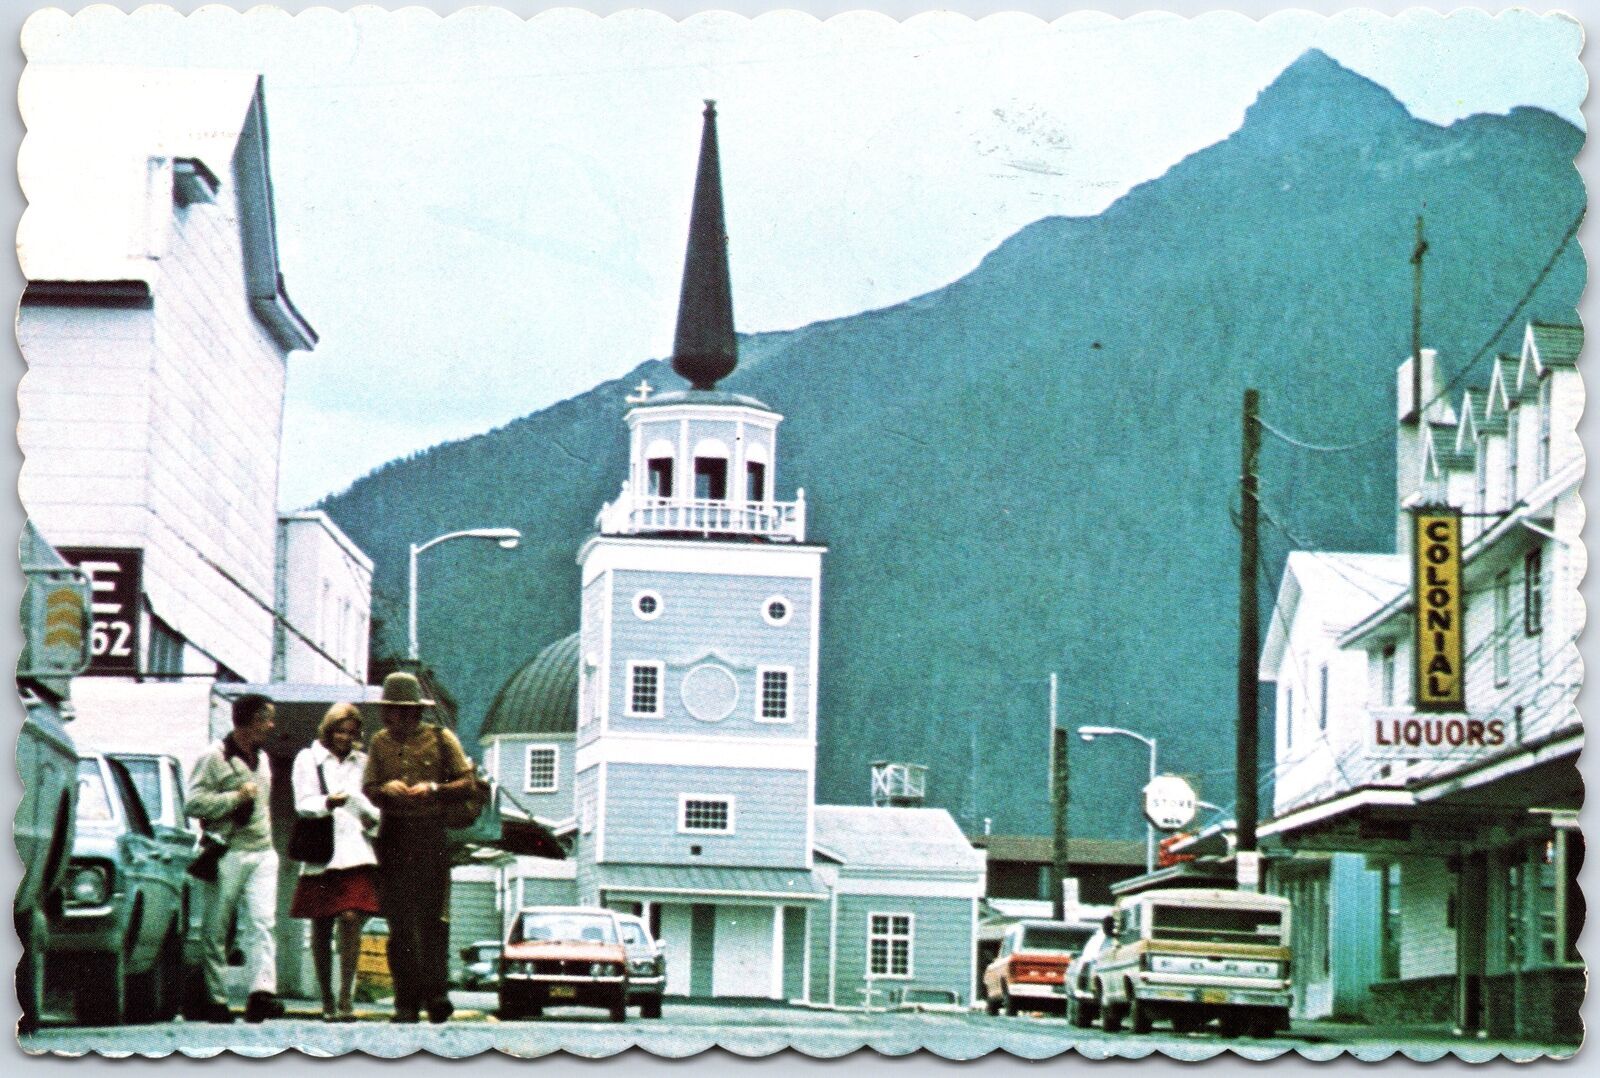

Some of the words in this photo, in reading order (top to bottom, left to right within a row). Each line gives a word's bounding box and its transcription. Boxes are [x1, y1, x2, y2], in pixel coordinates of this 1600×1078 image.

[1425, 520, 1452, 698] COLONIAL
[1375, 719, 1505, 747] LIQUORS
[1160, 959, 1270, 975] FORD
